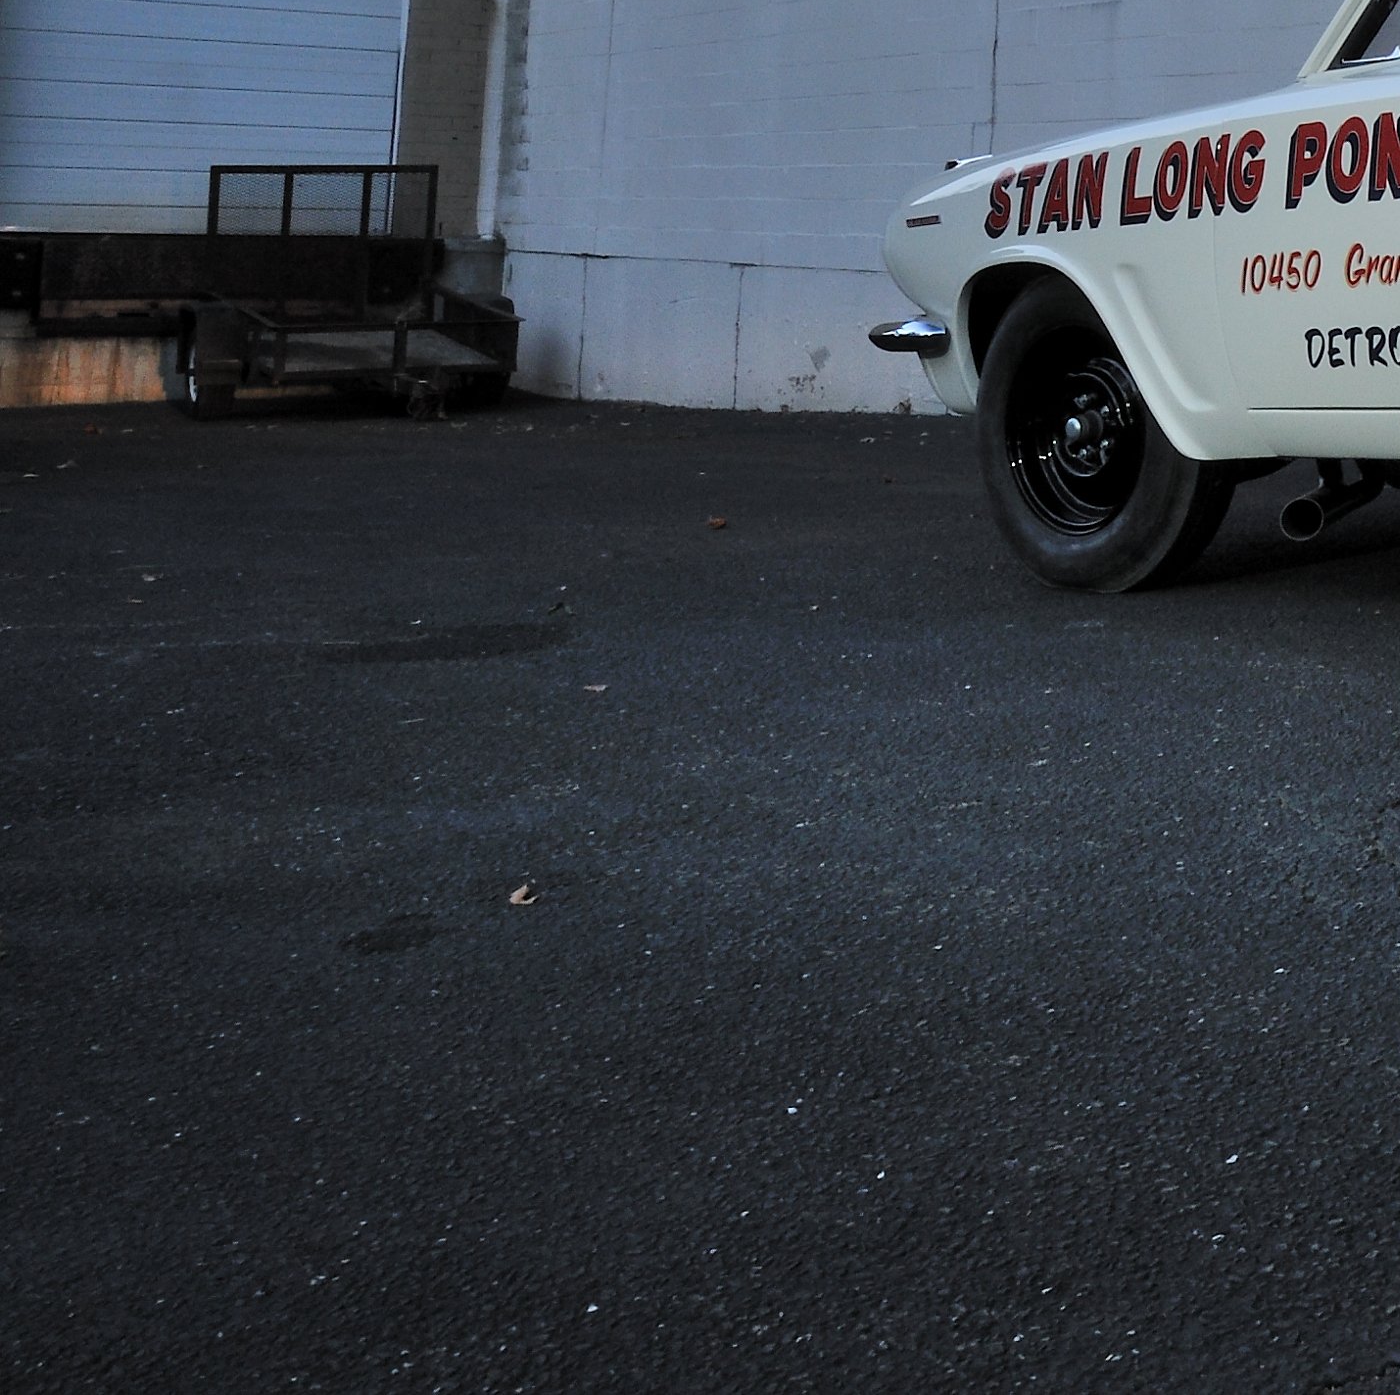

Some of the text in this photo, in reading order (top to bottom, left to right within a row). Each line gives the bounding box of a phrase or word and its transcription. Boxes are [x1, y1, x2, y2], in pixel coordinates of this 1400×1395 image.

[983, 151, 1110, 240] STAN
[1119, 128, 1267, 228] LONG
[1241, 248, 1323, 296] 10450
